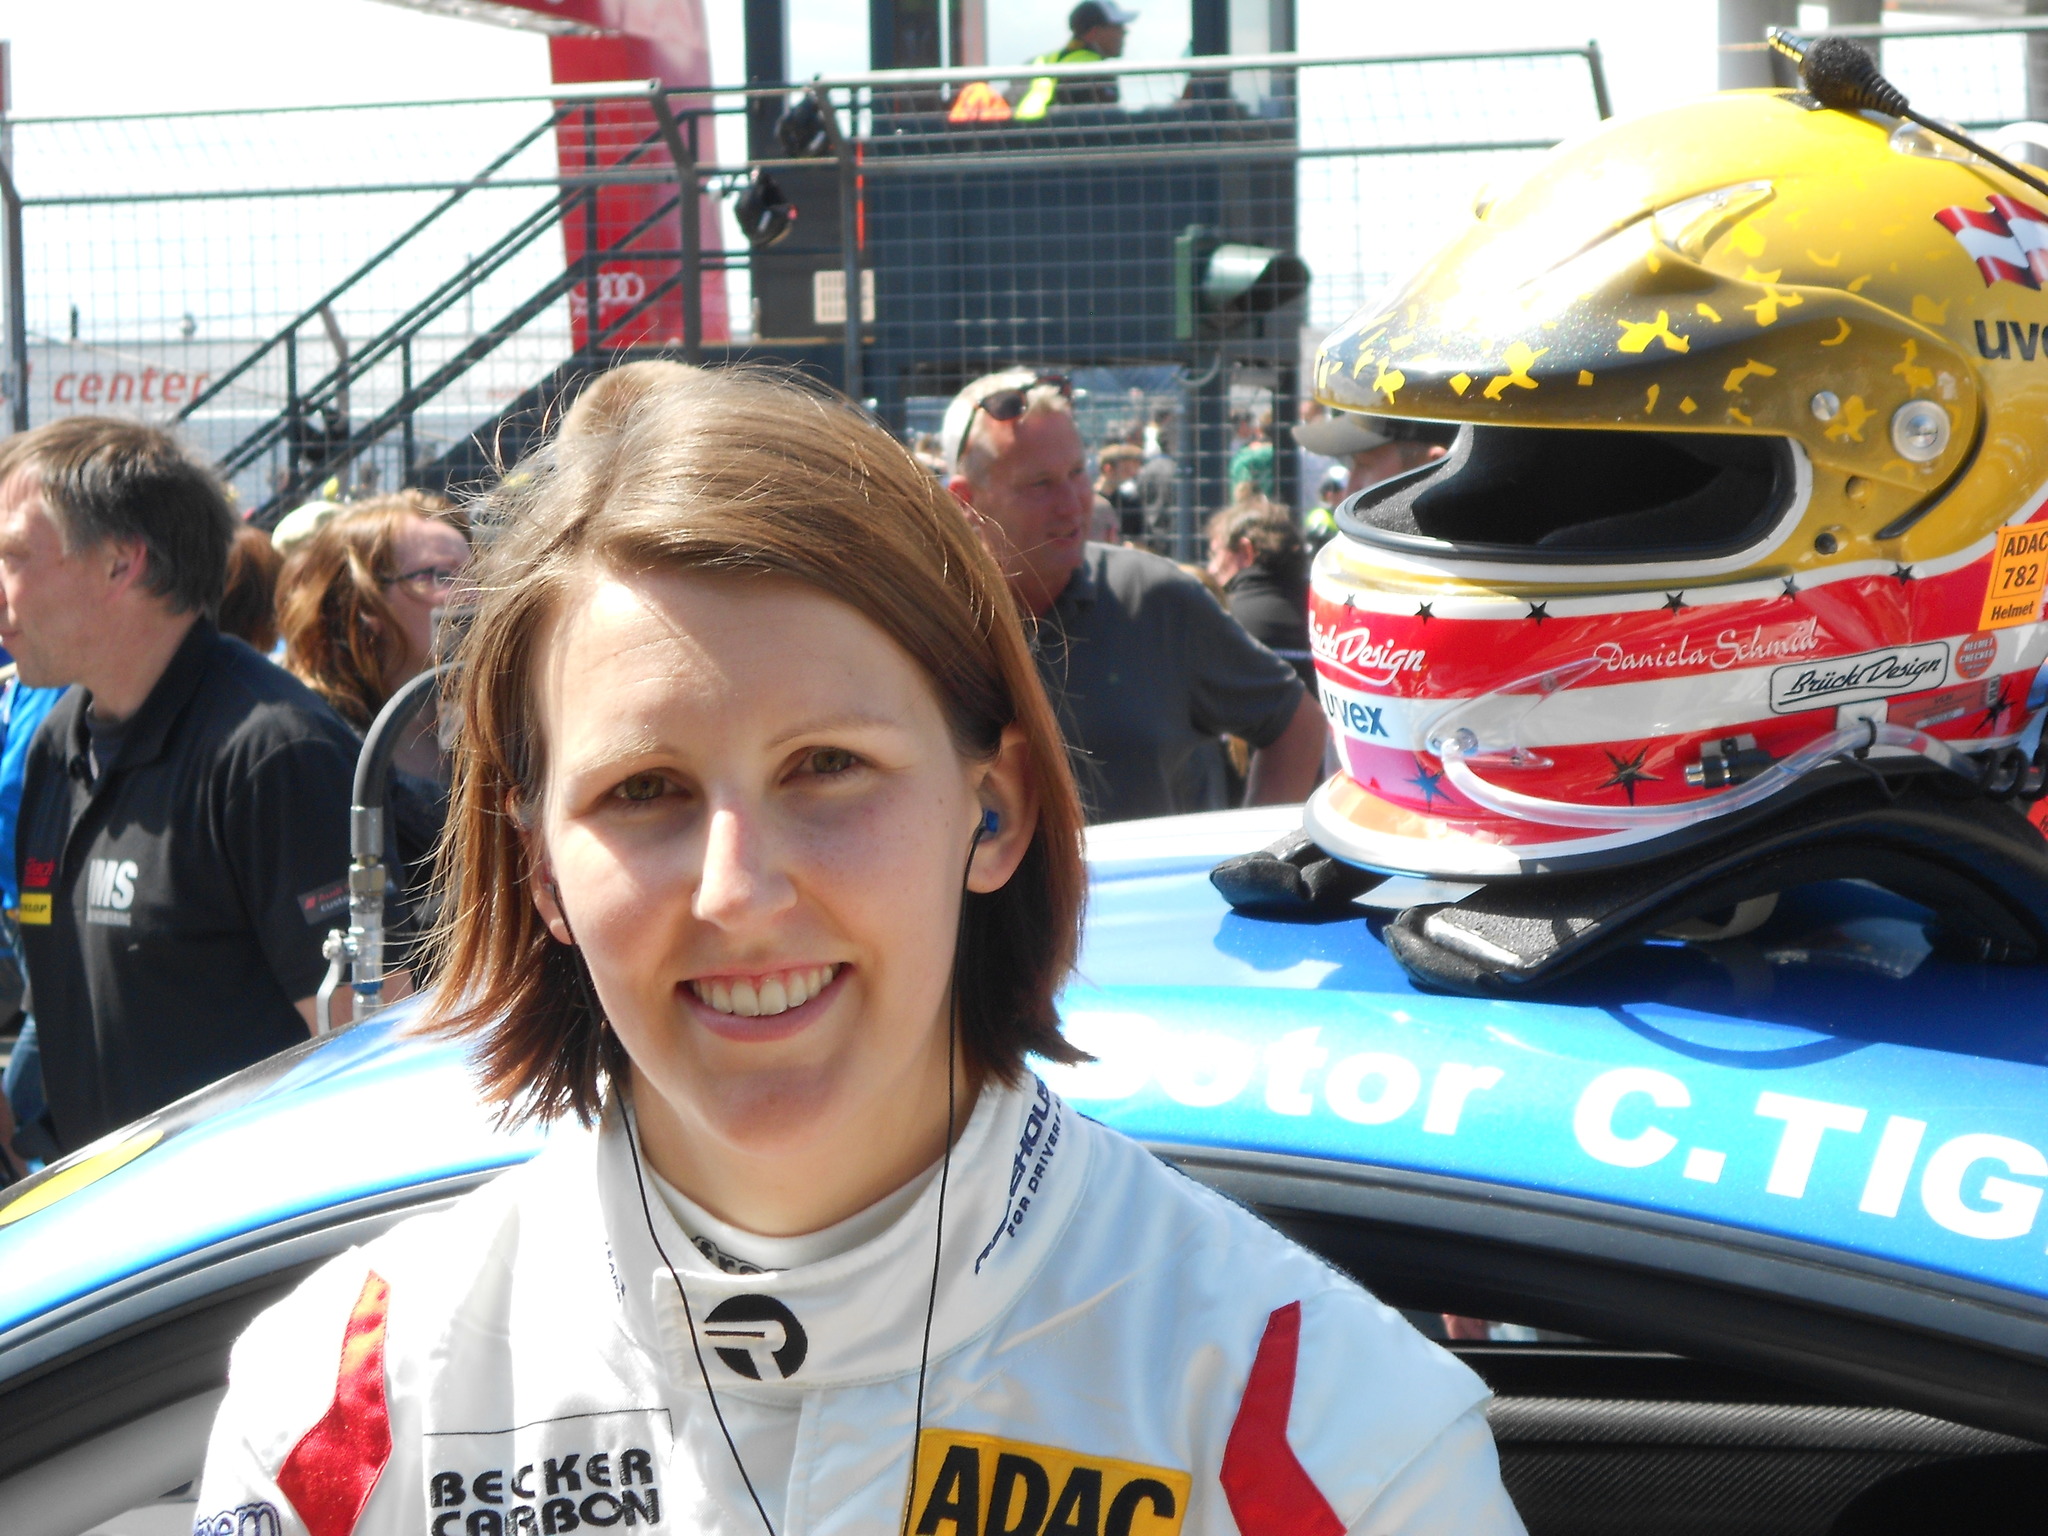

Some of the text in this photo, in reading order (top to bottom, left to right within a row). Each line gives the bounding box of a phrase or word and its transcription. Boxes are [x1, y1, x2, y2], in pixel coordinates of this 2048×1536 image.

[1974, 319, 2048, 361] uv
[53, 365, 208, 404] center
[2004, 531, 2048, 558] ADAC
[2003, 563, 2039, 590] 782
[1991, 601, 2035, 621] Helmet
[1338, 627, 1426, 678] Design
[1593, 616, 1819, 672] Daniela Schmid
[1867, 656, 1943, 687] Design
[1324, 688, 1390, 738] uvex
[1006, 1196, 1031, 1238] FOR
[430, 1448, 654, 1509] BECKER
[916, 1444, 1176, 1536] ADAC
[431, 1488, 661, 1536] CARBON
